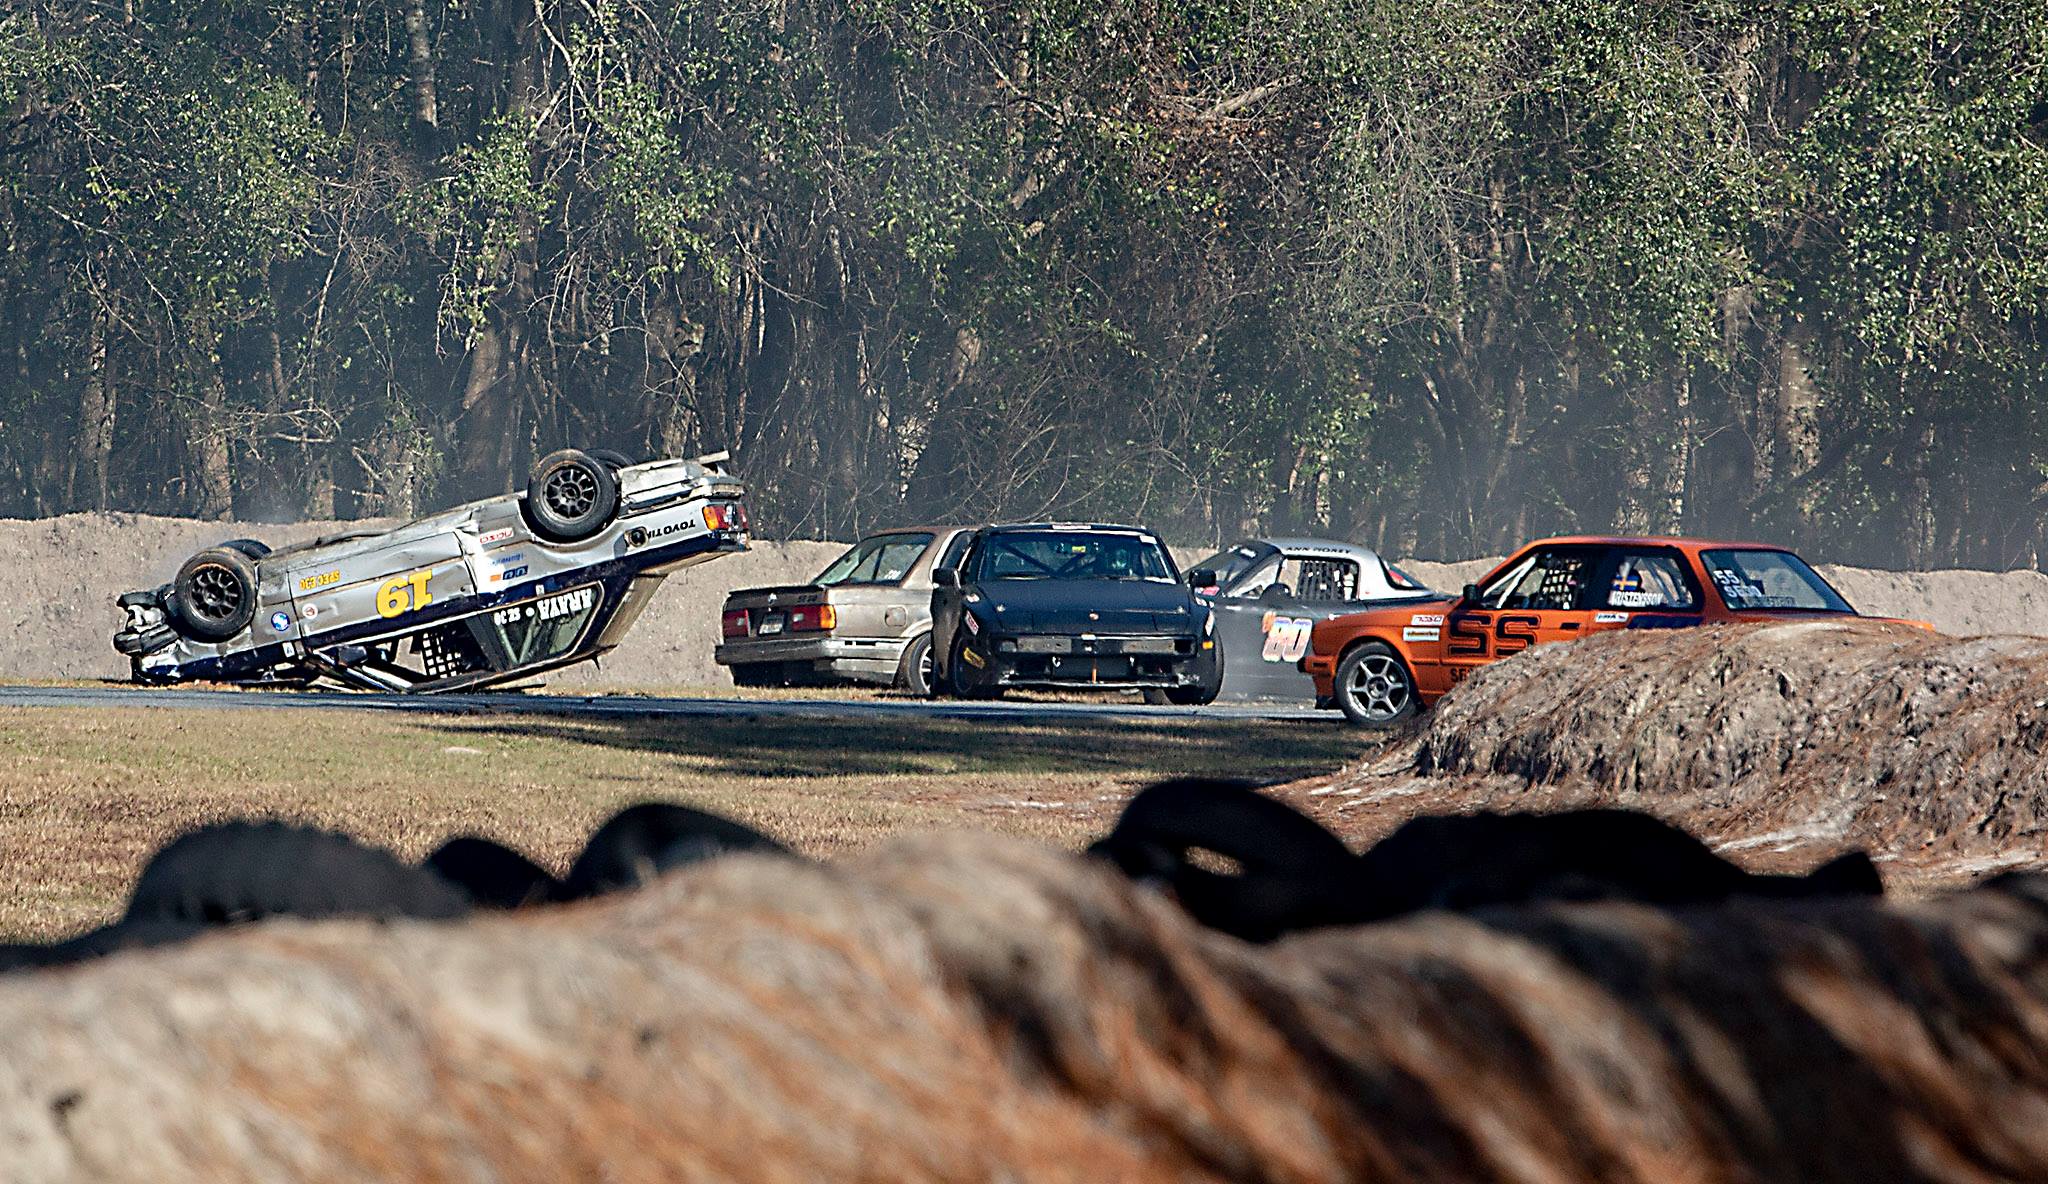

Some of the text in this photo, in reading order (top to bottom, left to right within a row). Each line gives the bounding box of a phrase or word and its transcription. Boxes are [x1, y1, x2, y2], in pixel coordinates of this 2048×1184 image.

[663, 519, 696, 535] TOYO
[319, 570, 341, 586] SPEC
[377, 569, 433, 618] 19
[537, 588, 593, 621] ARAYA
